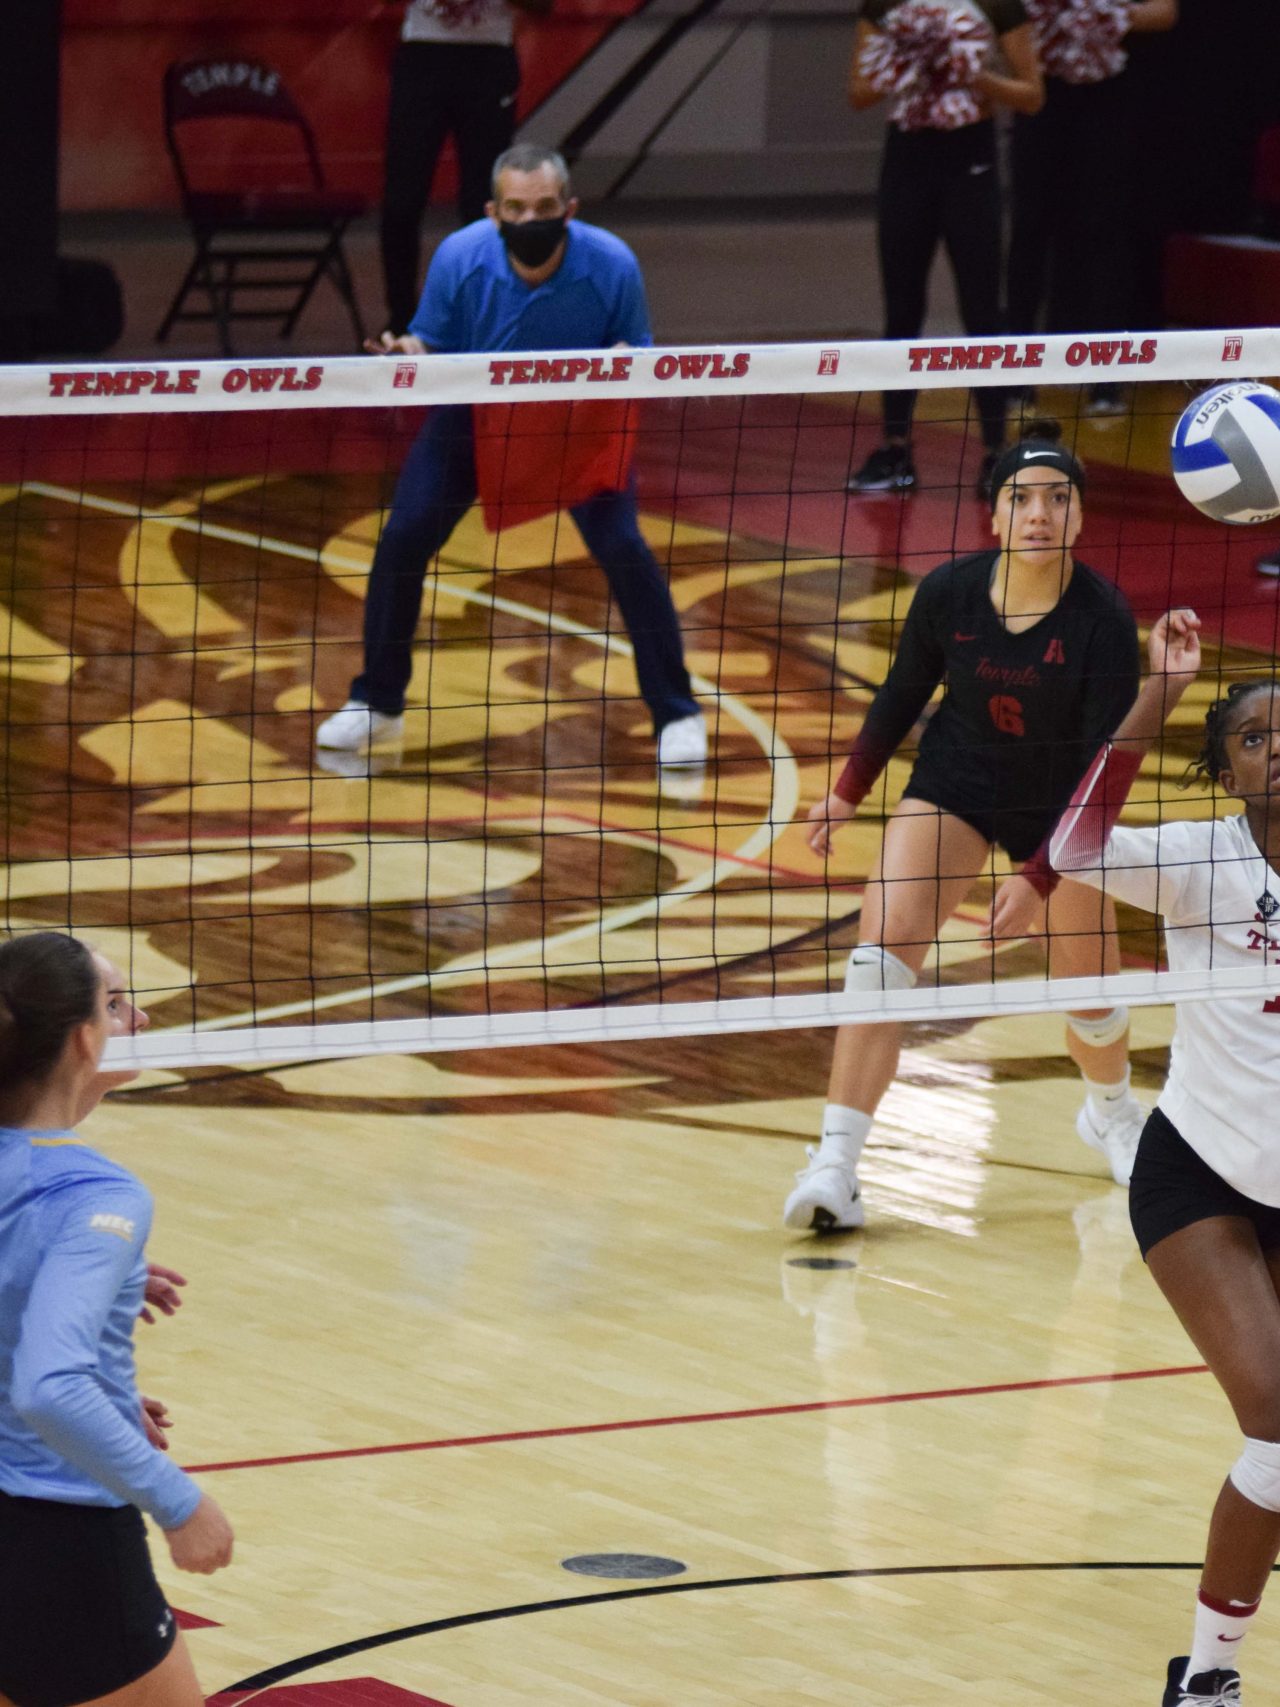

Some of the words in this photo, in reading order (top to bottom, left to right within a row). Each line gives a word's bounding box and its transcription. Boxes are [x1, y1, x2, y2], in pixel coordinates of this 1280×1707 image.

[182, 63, 281, 95] TEMPLE
[489, 357, 633, 385] TEMPLE
[654, 353, 750, 380] OWLS
[908, 343, 1044, 371] TEMPLE
[1065, 340, 1158, 365] OWLS
[50, 370, 199, 396] TEMPLE
[223, 367, 322, 392] OWLS
[988, 695, 1025, 737] 6
